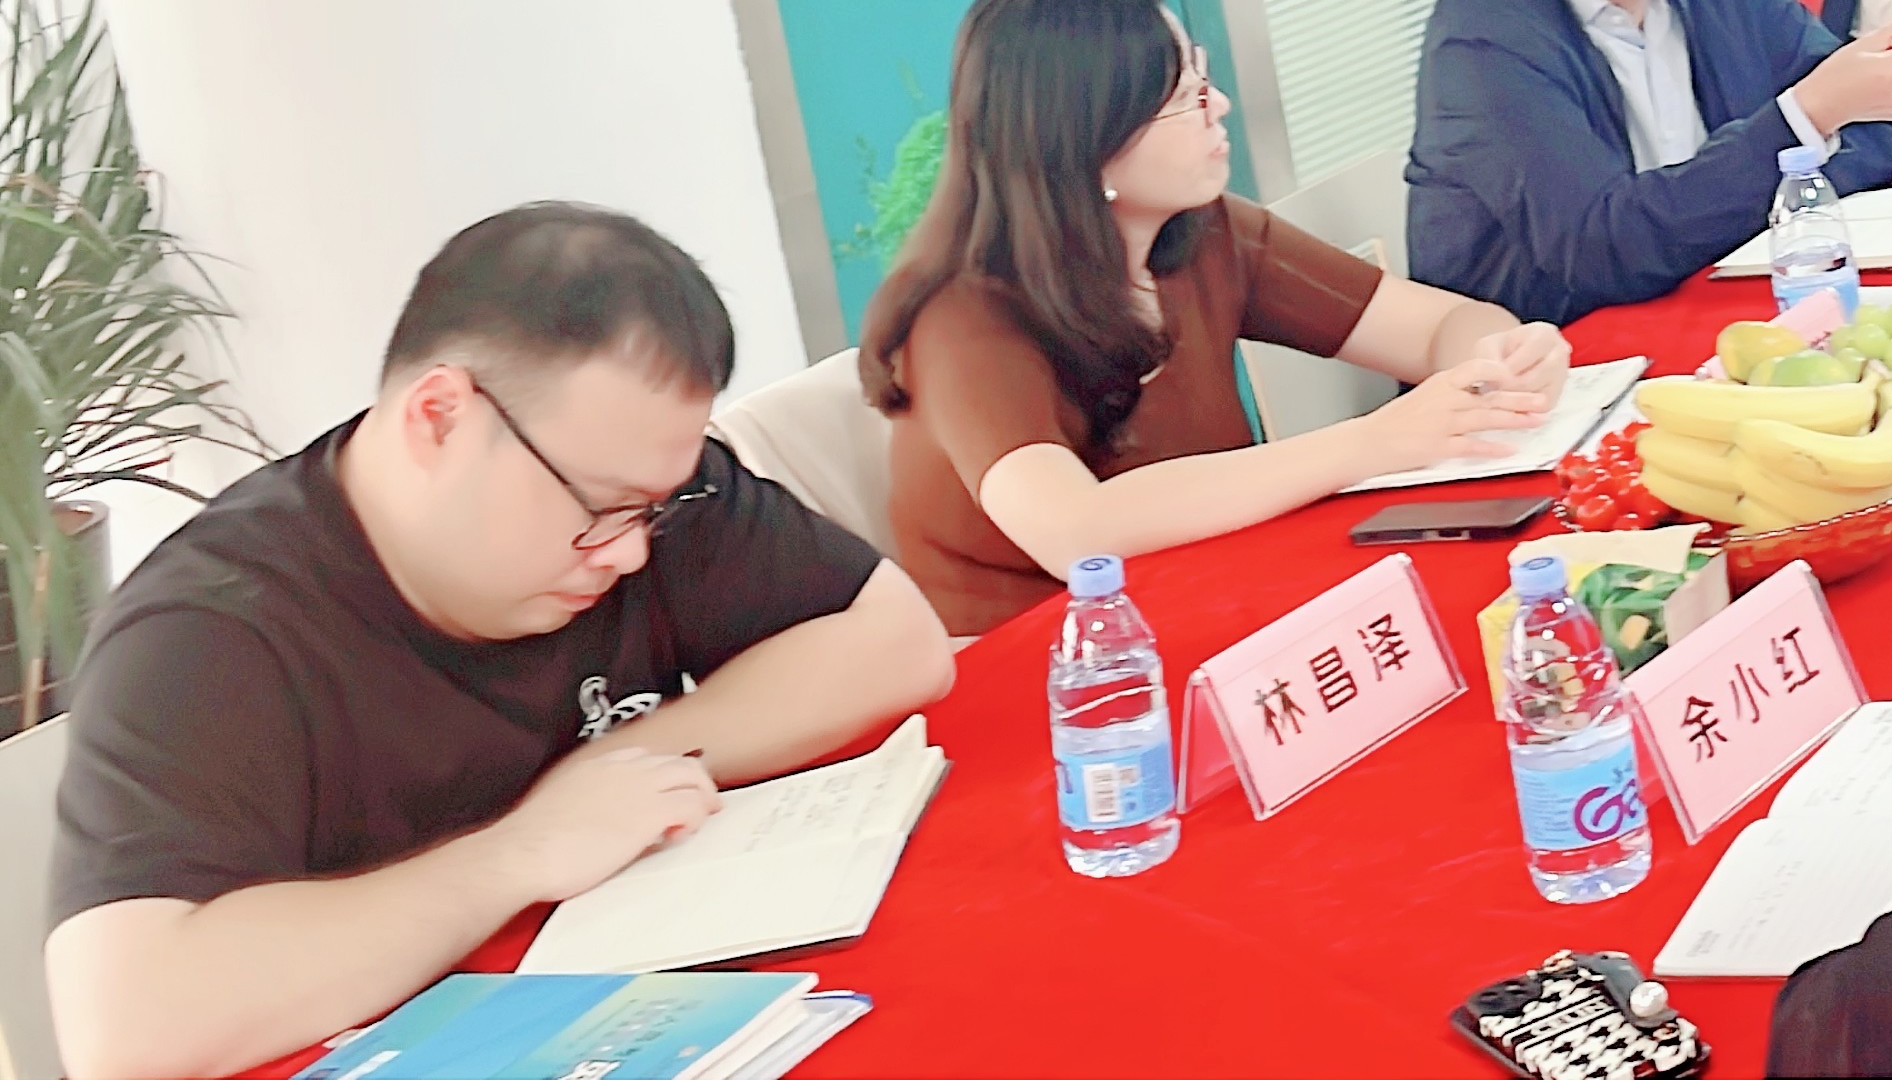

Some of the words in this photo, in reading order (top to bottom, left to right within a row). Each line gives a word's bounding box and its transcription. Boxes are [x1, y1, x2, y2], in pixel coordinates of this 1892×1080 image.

[1254, 613, 1411, 746] 林昌泽
[1680, 626, 1820, 763] 余小红
